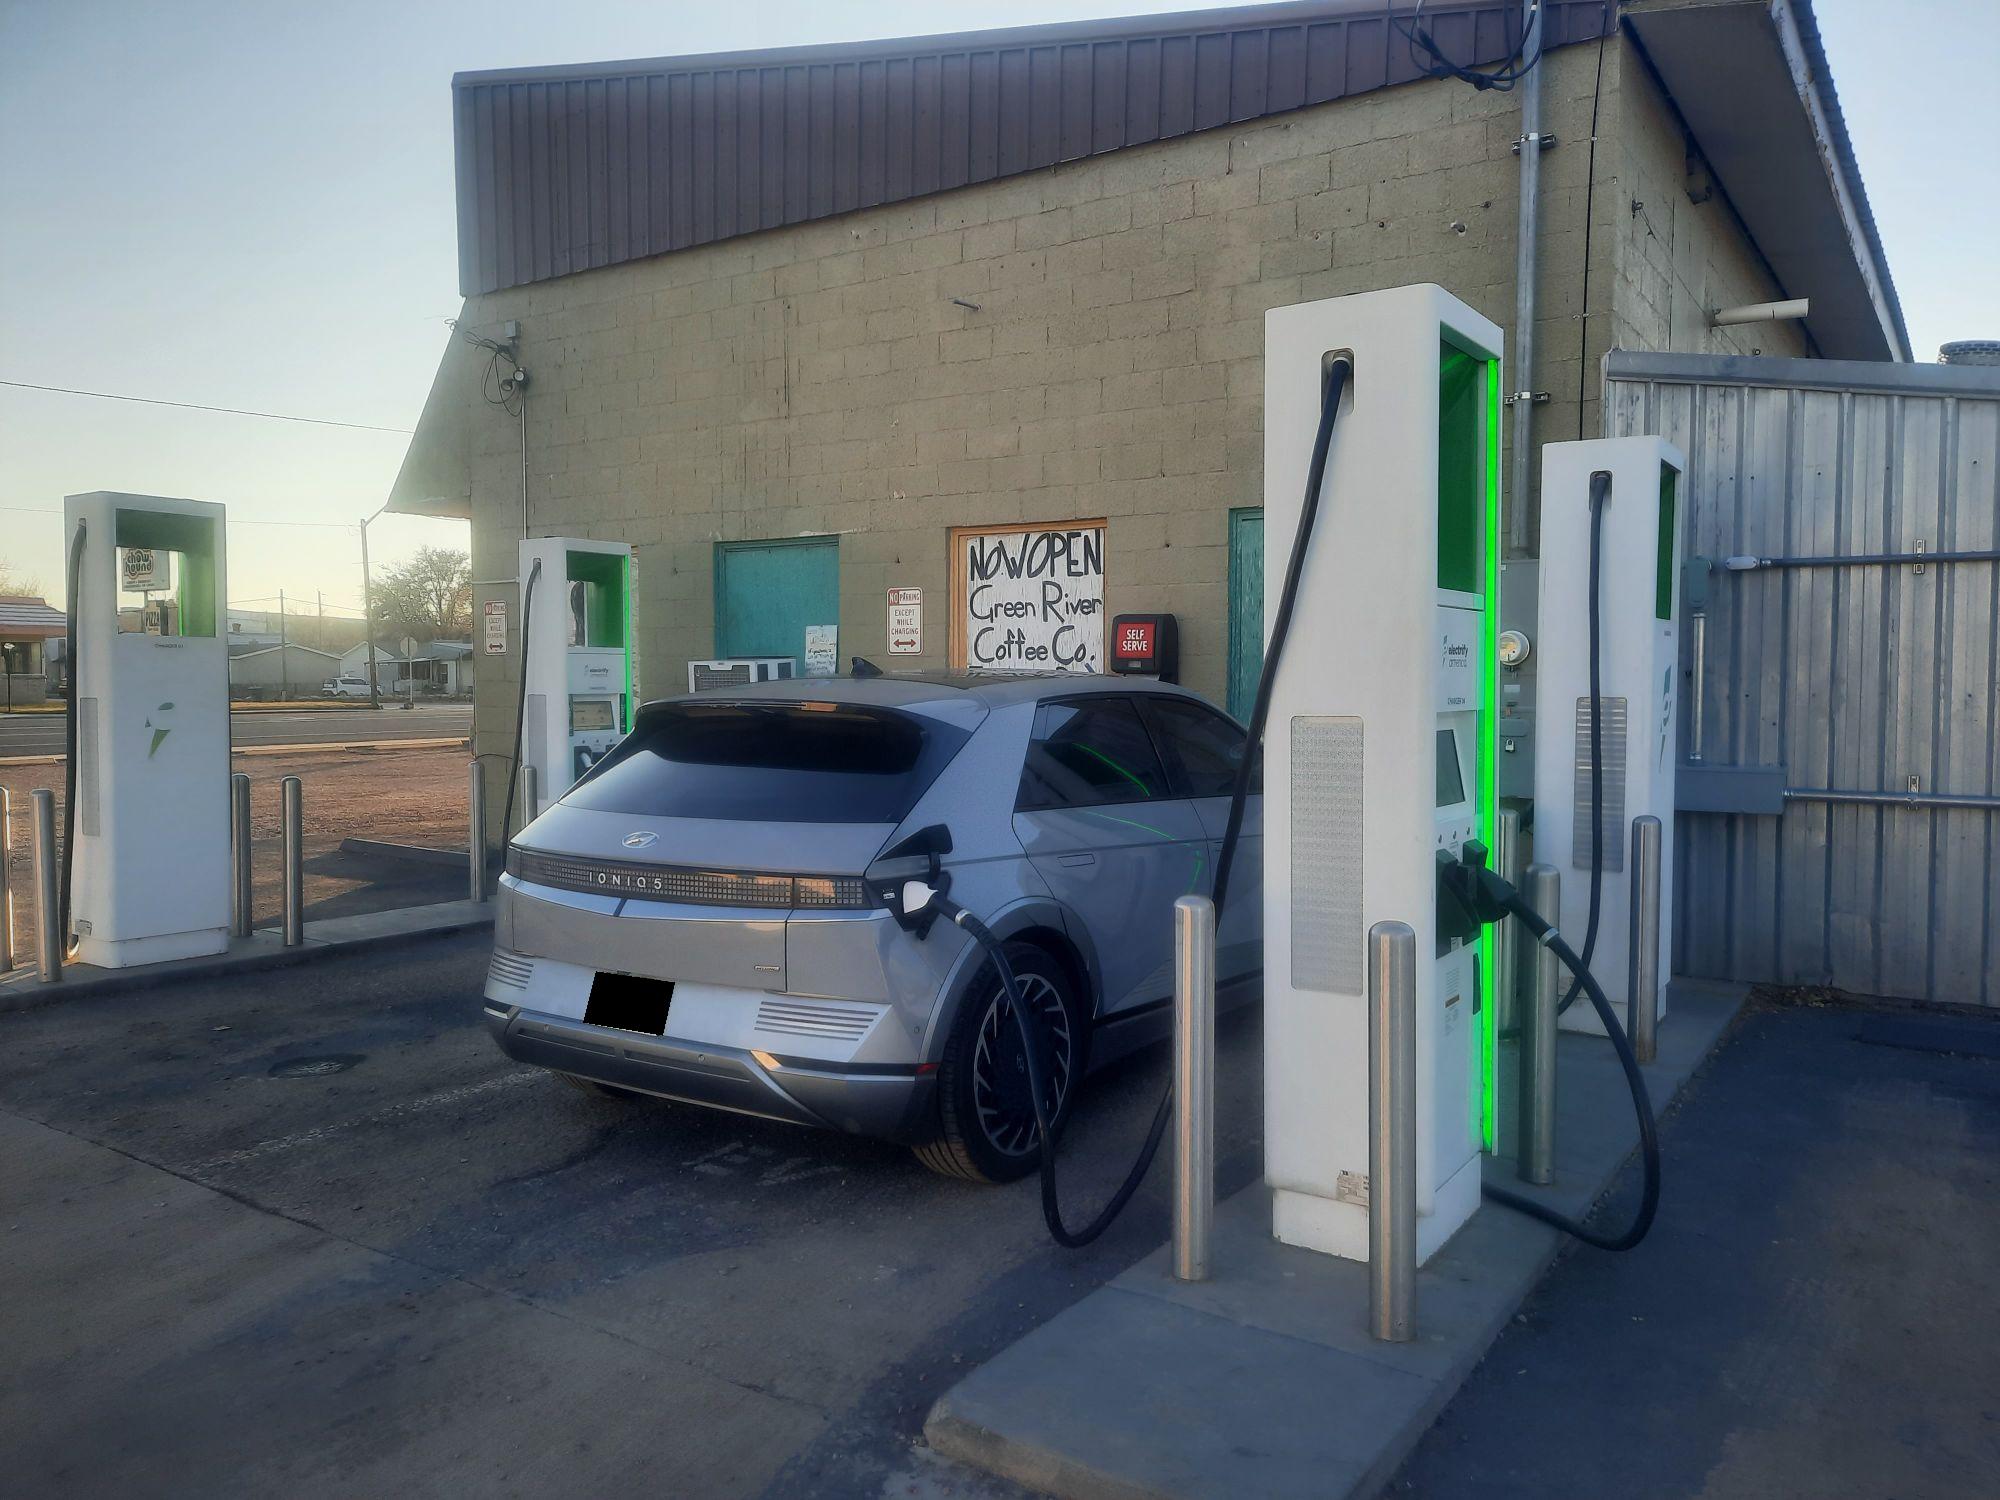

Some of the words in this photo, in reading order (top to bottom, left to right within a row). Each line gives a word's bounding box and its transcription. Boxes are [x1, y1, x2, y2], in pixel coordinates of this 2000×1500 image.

[1026, 528, 1103, 579] OPEN
[890, 592, 899, 604] NO
[900, 592, 920, 602] PARKING
[969, 584, 1037, 624] Green
[1042, 580, 1103, 624] River
[894, 609, 915, 617] EXCEPT
[896, 618, 914, 626] WHILE
[891, 627, 919, 636] CHARGING
[1126, 629, 1145, 640] SELF
[974, 626, 1049, 664] Coffee
[1052, 624, 1096, 666] Co.
[1122, 640, 1148, 652] SERVE
[1448, 643, 1469, 658] electrify
